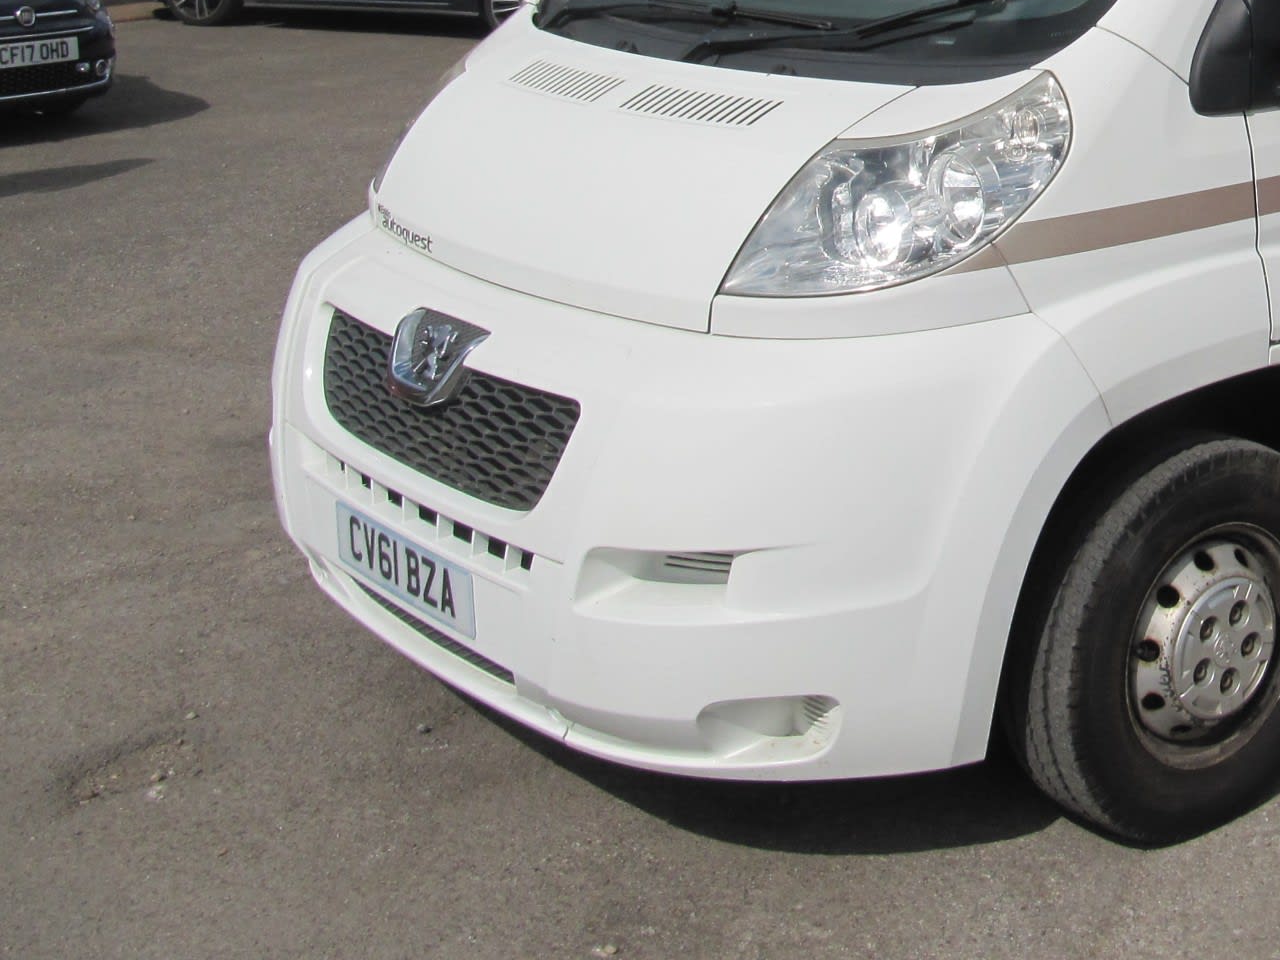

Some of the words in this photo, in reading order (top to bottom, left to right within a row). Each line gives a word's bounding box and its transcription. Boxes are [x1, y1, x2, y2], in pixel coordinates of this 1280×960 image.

[0, 44, 35, 65] CF17
[40, 41, 69, 60] OHD
[382, 216, 433, 254] autoquest
[349, 515, 399, 586] CV61
[405, 546, 456, 619] BZA
